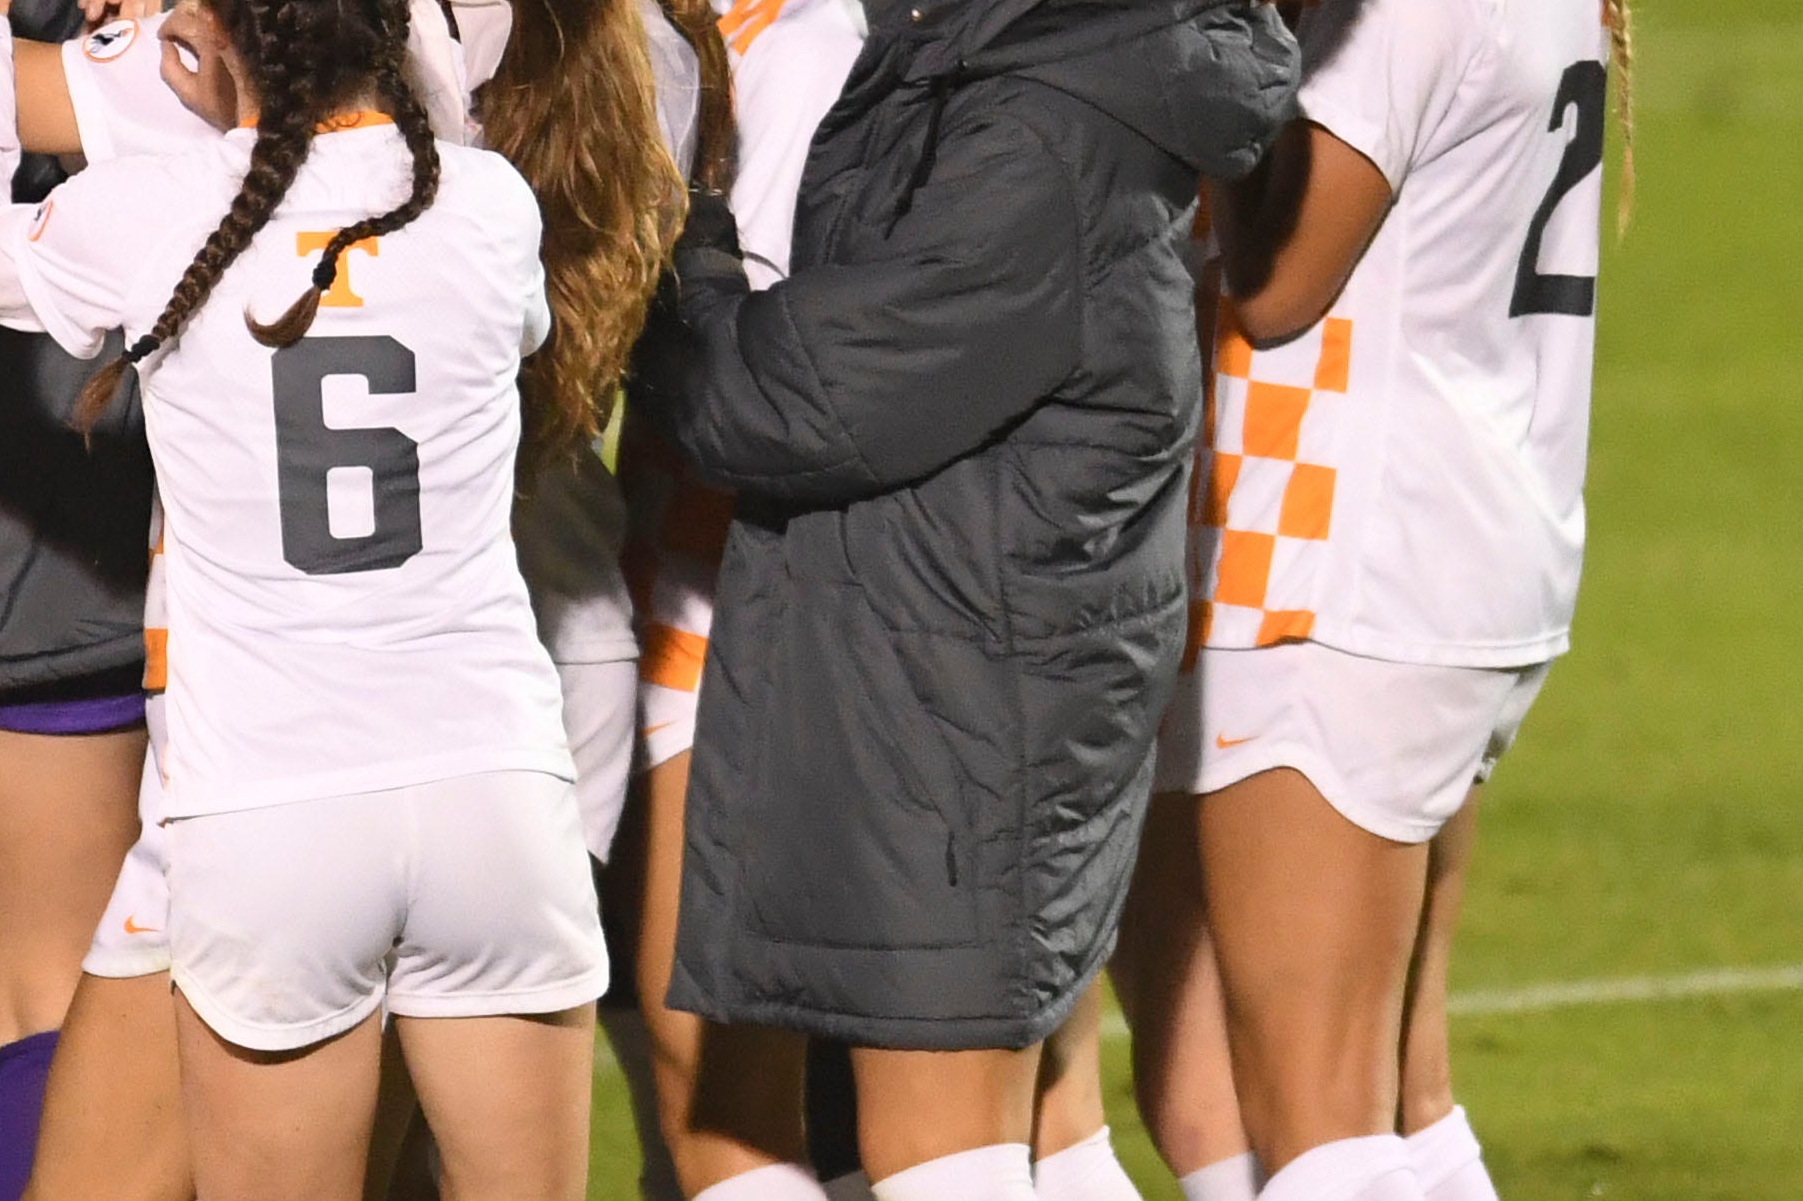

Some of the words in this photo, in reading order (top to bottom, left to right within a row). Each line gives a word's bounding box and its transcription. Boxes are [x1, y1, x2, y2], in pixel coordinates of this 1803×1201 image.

[296, 231, 379, 307] T
[1508, 60, 1609, 319] 2
[271, 335, 423, 576] 6
